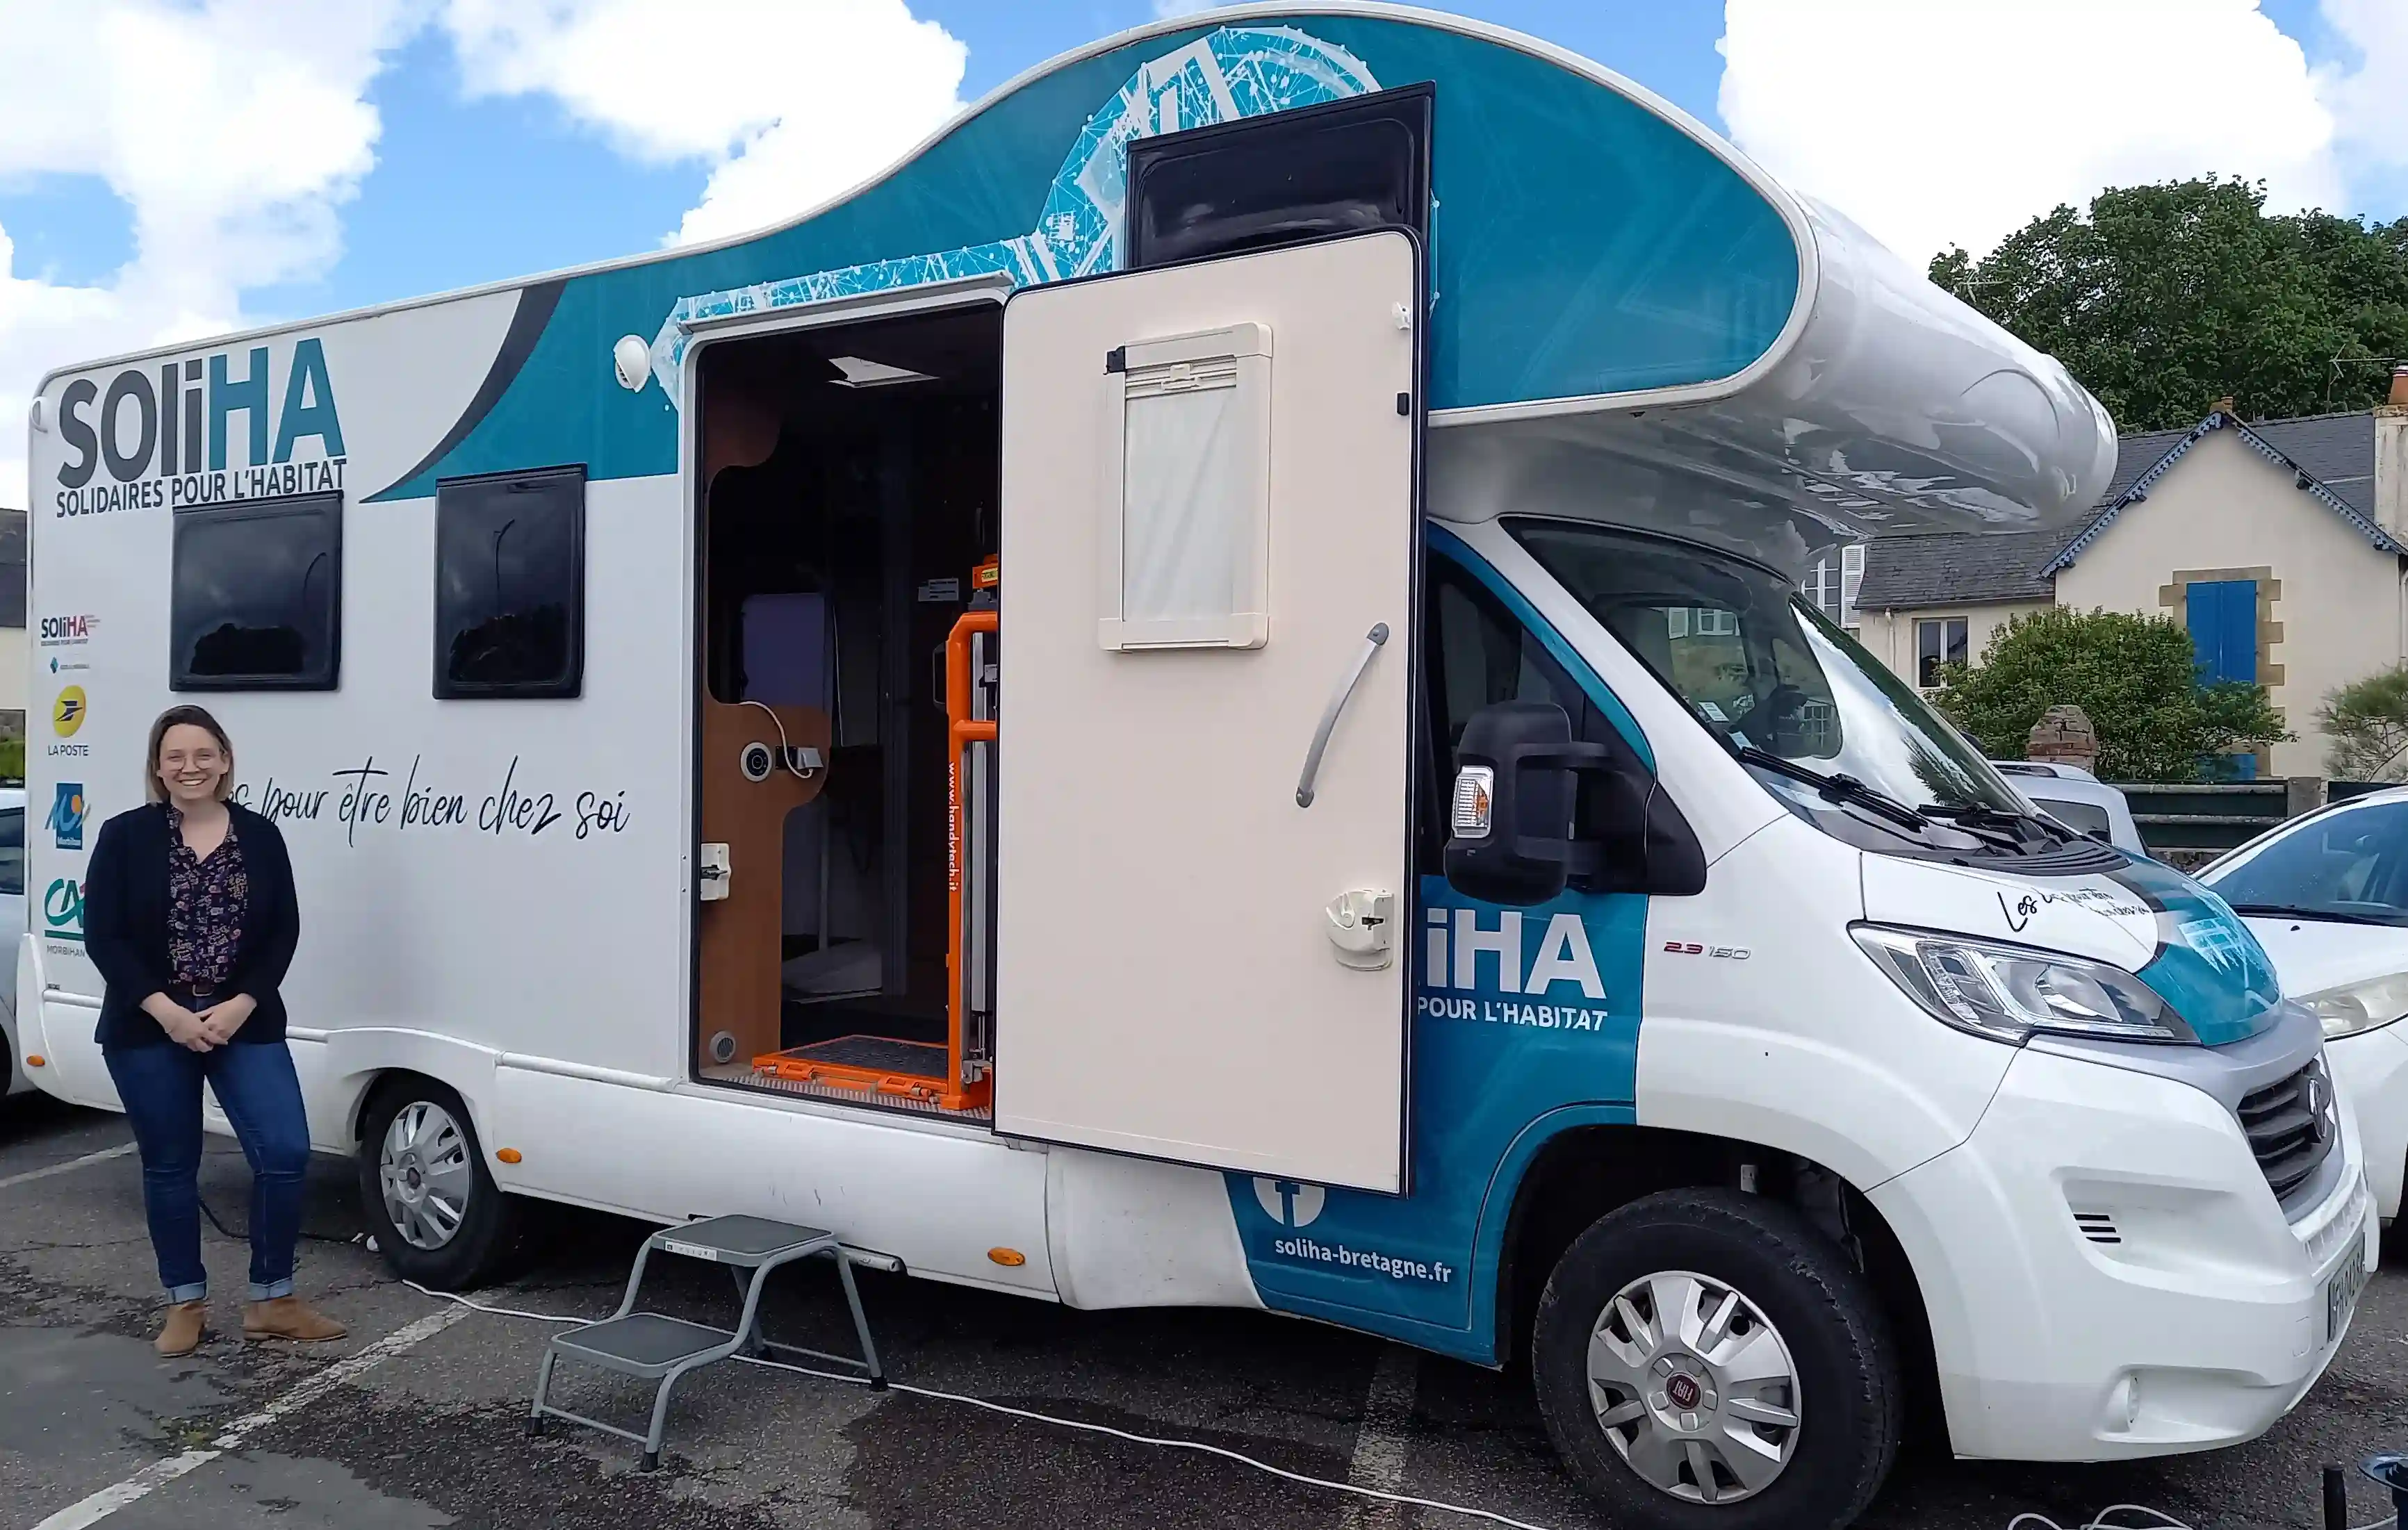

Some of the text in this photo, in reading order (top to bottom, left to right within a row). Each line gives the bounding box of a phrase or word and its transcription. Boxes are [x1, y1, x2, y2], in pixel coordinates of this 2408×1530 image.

[56, 458, 347, 518] SOLIDAIRES POUR L'HABITAT
[47, 744, 89, 757] LA POSTE
[332, 756, 391, 848] être
[400, 754, 468, 830] bien
[479, 755, 562, 836] chez
[575, 791, 630, 840] soi
[948, 761, 960, 892] www.handytech.it
[1418, 996, 1608, 1031] POUR L'HABITAT
[1275, 1238, 1452, 1283] soliha-bretagne.fr
[1672, 1380, 1694, 1402] FIAT
